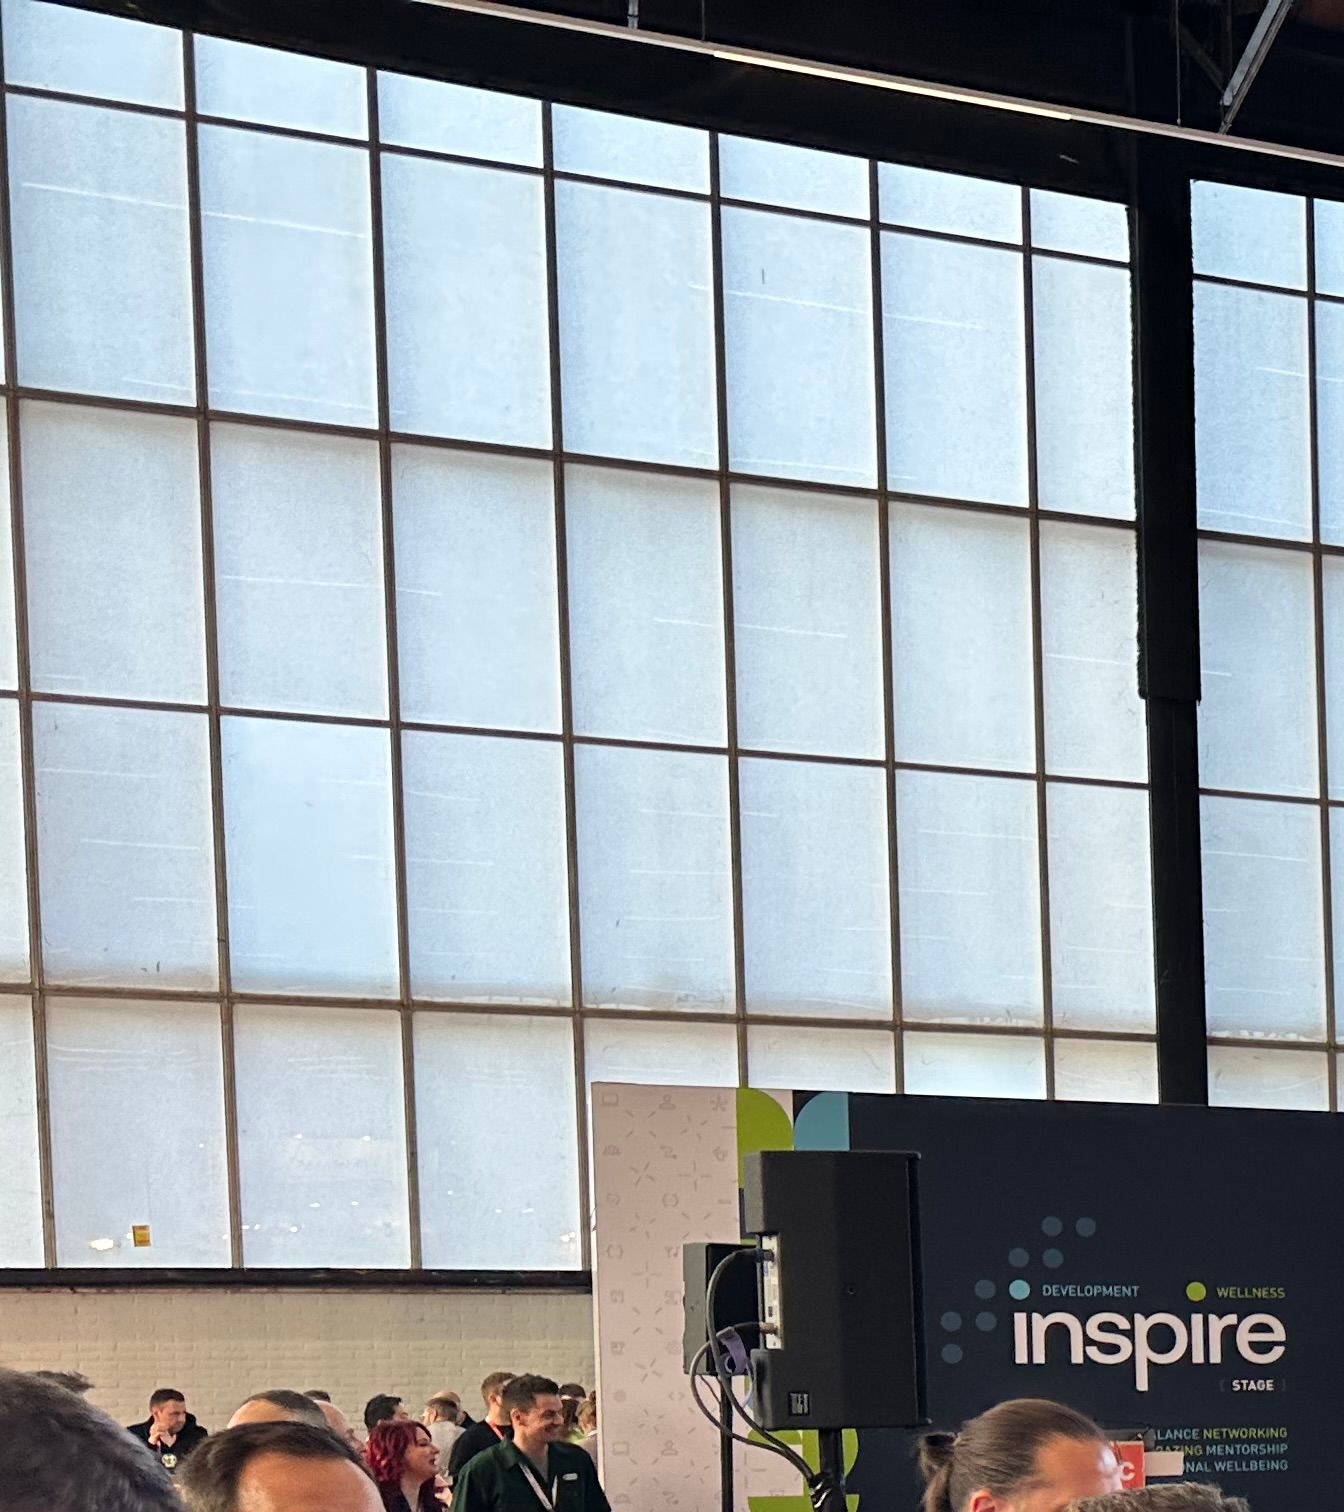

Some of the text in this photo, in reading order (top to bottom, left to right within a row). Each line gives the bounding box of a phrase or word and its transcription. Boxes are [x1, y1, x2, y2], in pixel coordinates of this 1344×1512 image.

[1041, 1284, 1286, 1299] DEVELOPMENT WELLNESS
[1013, 1311, 1286, 1391] inspire
[1232, 1379, 1274, 1391] STAGE
[1155, 1427, 1288, 1440] LANCE NETWORKING
[1206, 1443, 1289, 1456] MENTORSHIP
[1214, 1460, 1289, 1472] WELLBEING
